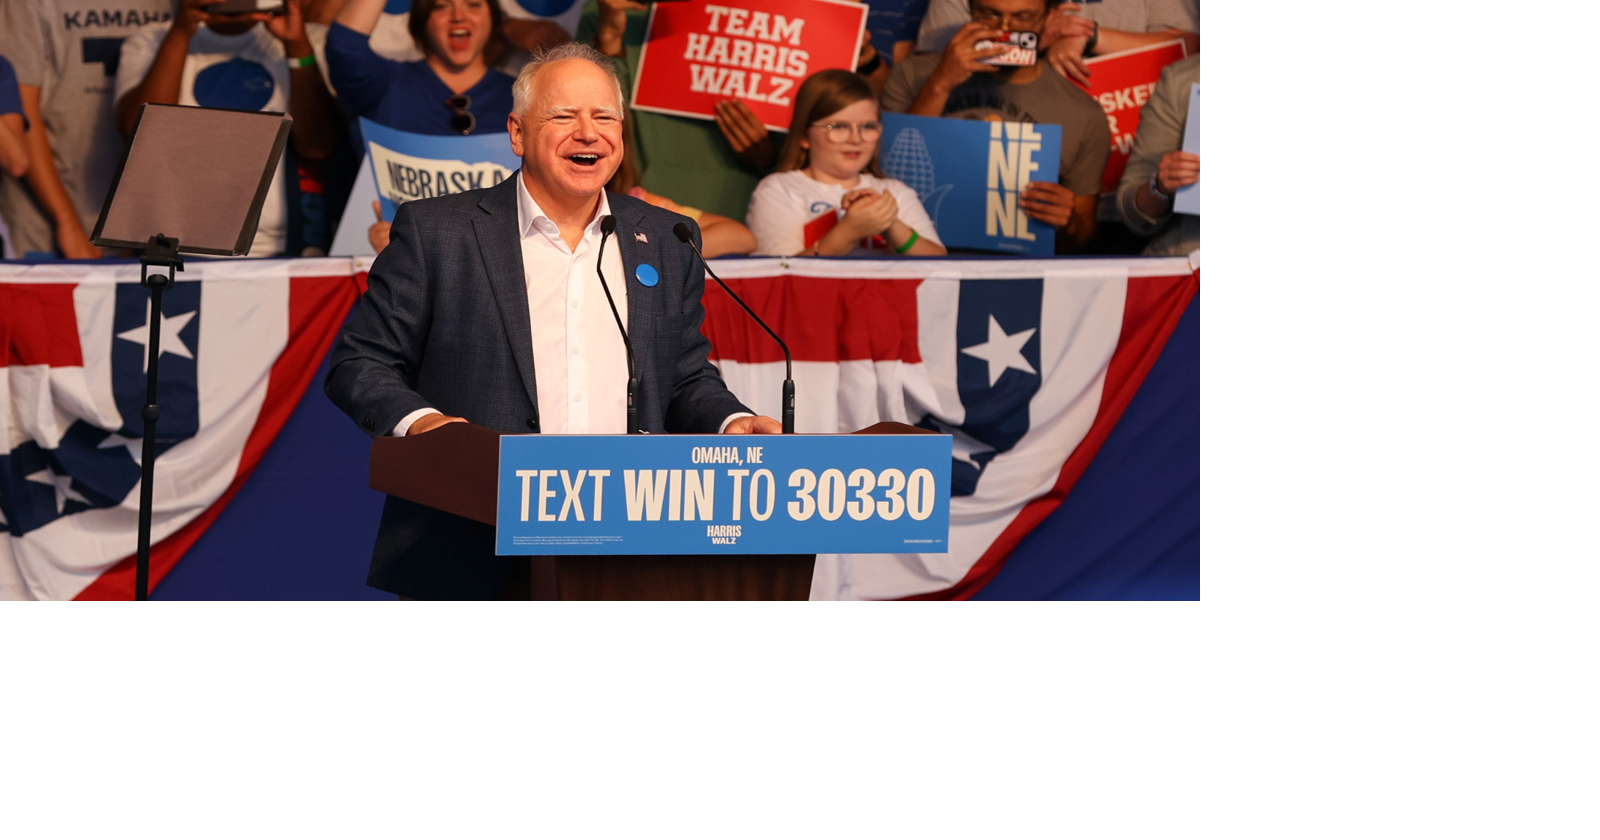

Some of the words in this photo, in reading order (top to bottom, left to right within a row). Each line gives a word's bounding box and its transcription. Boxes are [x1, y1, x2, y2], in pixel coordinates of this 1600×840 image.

[704, 4, 805, 46] TEAM
[684, 33, 810, 78] HARRIS
[689, 64, 795, 107] WALZ
[1092, 82, 1156, 113] SKE
[691, 446, 744, 466] OMAHA,
[747, 446, 763, 464] NE
[515, 469, 611, 522] TEXT
[623, 469, 715, 521] WIN
[728, 468, 776, 521] TO
[787, 468, 936, 521] 30330
[707, 525, 742, 537] HARRIS
[712, 537, 737, 545] WALZ
